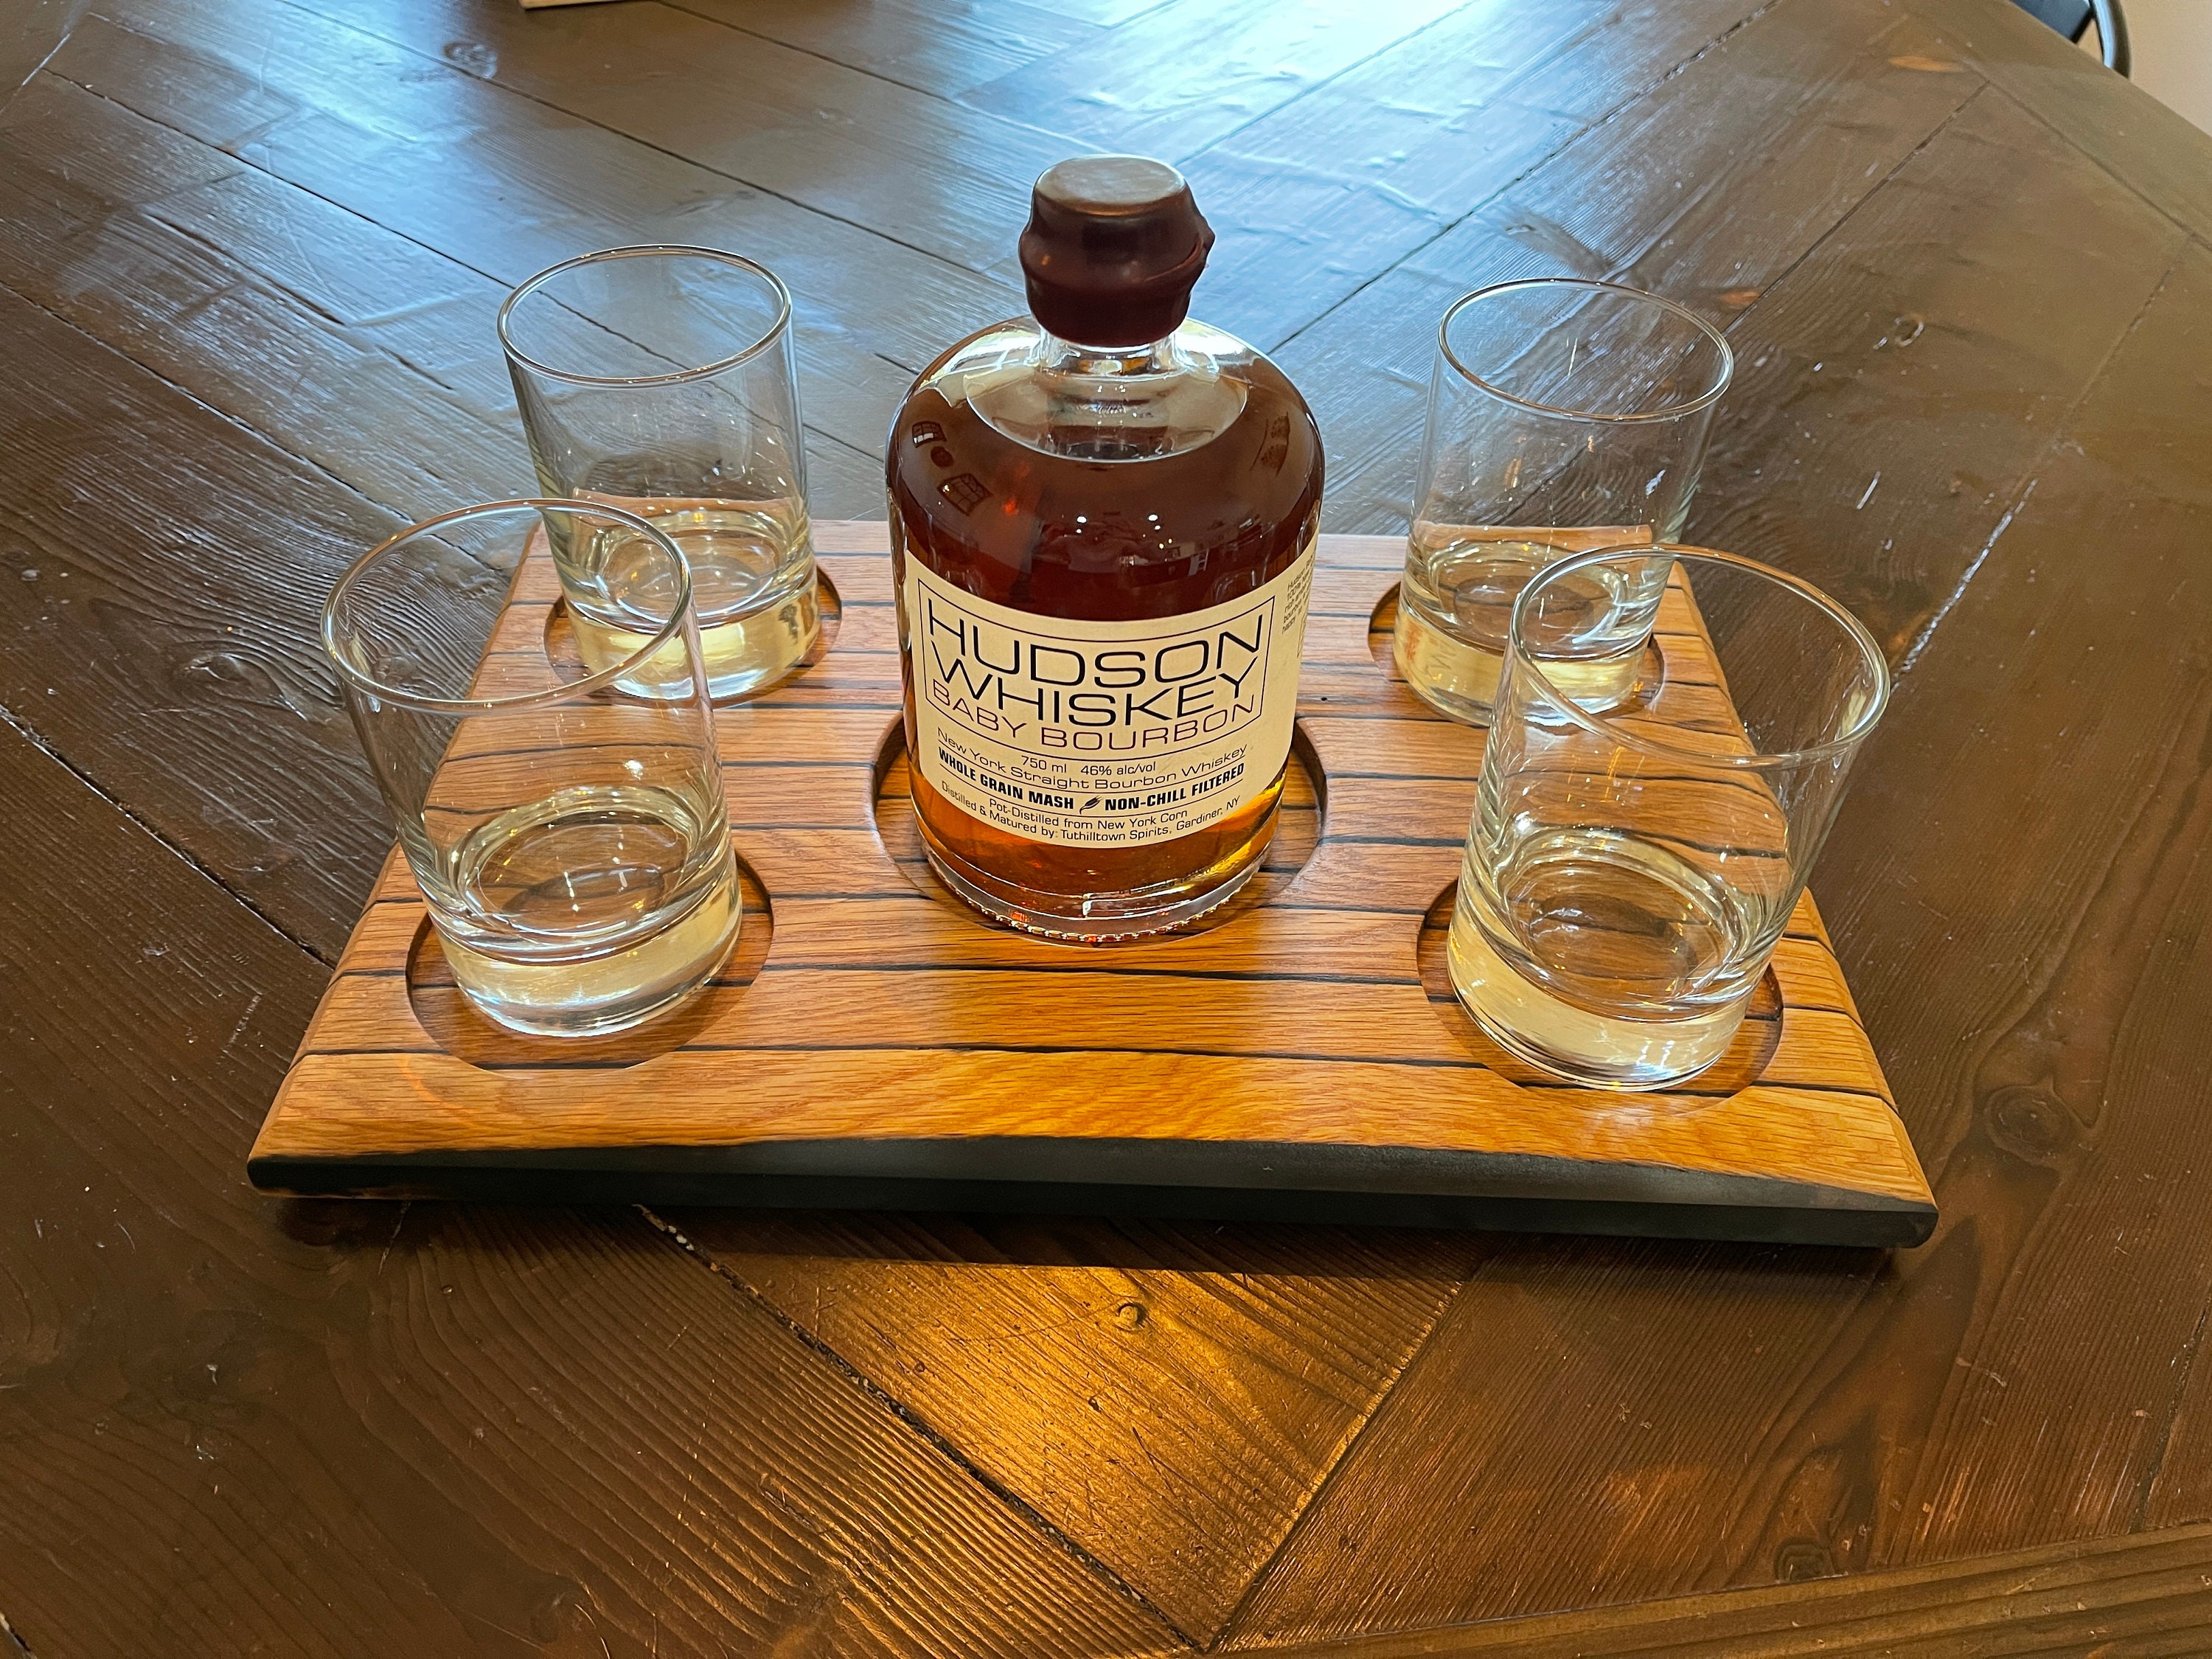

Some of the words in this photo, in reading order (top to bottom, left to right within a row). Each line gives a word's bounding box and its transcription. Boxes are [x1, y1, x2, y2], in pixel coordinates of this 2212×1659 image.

[928, 598, 1262, 688] HUDSON
[931, 640, 1258, 726] WHISKEY
[933, 679, 1026, 738] BABY
[1041, 694, 1254, 751] BOURBON
[938, 727, 967, 754] New
[970, 748, 1006, 773] York
[1010, 767, 1089, 790] Straight
[1095, 773, 1177, 789] Bourbon
[1181, 744, 1247, 776] Whiskey
[939, 746, 976, 782] WHOLE
[980, 773, 1023, 800] GRAIN
[1029, 790, 1074, 810] MASH
[1105, 787, 1186, 810] NON-CHILL
[1192, 762, 1245, 796] FILTERED
[1021, 755, 1047, 771] 750
[1051, 763, 1067, 773] ml
[1080, 765, 1112, 776] 46%
[1116, 762, 1155, 775] alc/vol
[942, 781, 976, 811] Distilled
[980, 805, 987, 816] &
[990, 810, 1037, 833] Matured
[1060, 829, 1125, 841] Tuthilltown
[1226, 796, 1240, 811] NY
[990, 798, 1059, 827] Pot-Distilled
[1064, 818, 1093, 830] from
[1098, 821, 1124, 830] New
[1129, 817, 1156, 827] York
[1161, 810, 1187, 823] Corn
